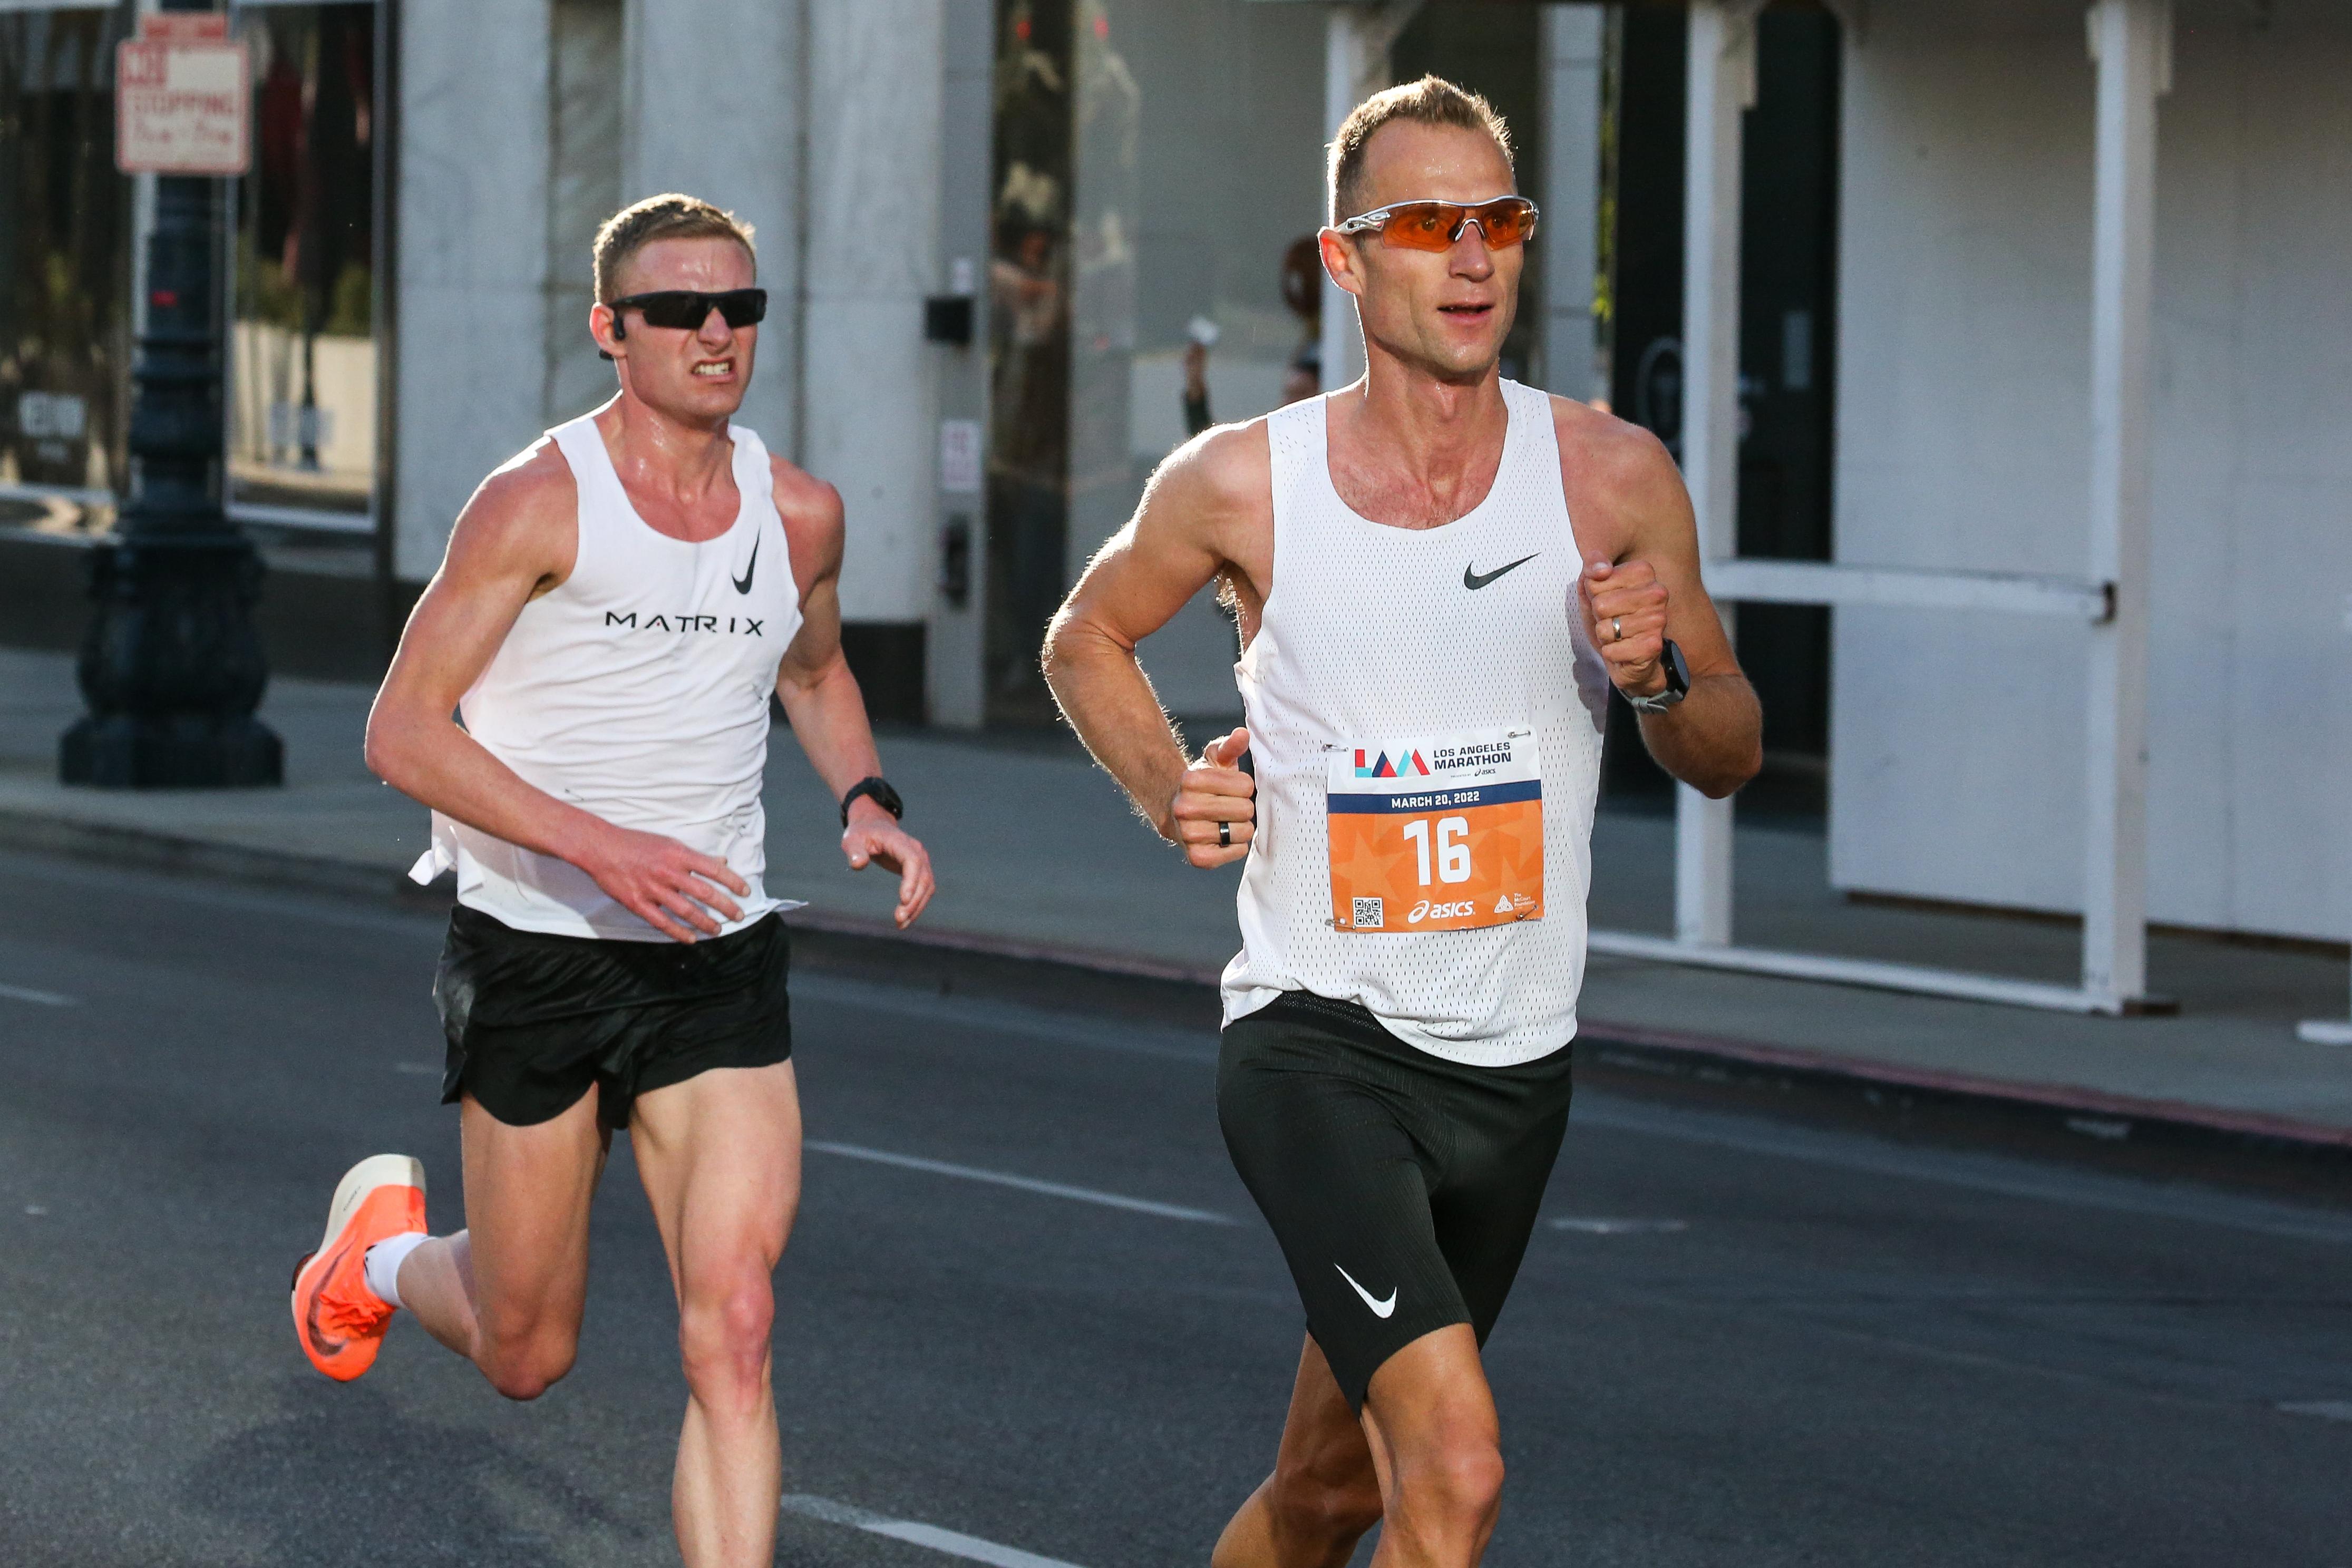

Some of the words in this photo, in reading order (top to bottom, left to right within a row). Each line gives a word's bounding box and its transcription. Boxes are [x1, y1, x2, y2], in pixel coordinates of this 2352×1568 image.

[606, 611, 764, 637] MATRIX
[1434, 748, 1455, 758] LOS
[1460, 742, 1510, 755] ANGELES
[1434, 752, 1512, 770] MARATHON
[1391, 795, 1432, 808] MARCH
[1435, 794, 1452, 806] 20,
[1454, 791, 1480, 803] 2022
[1403, 816, 1471, 886] 16
